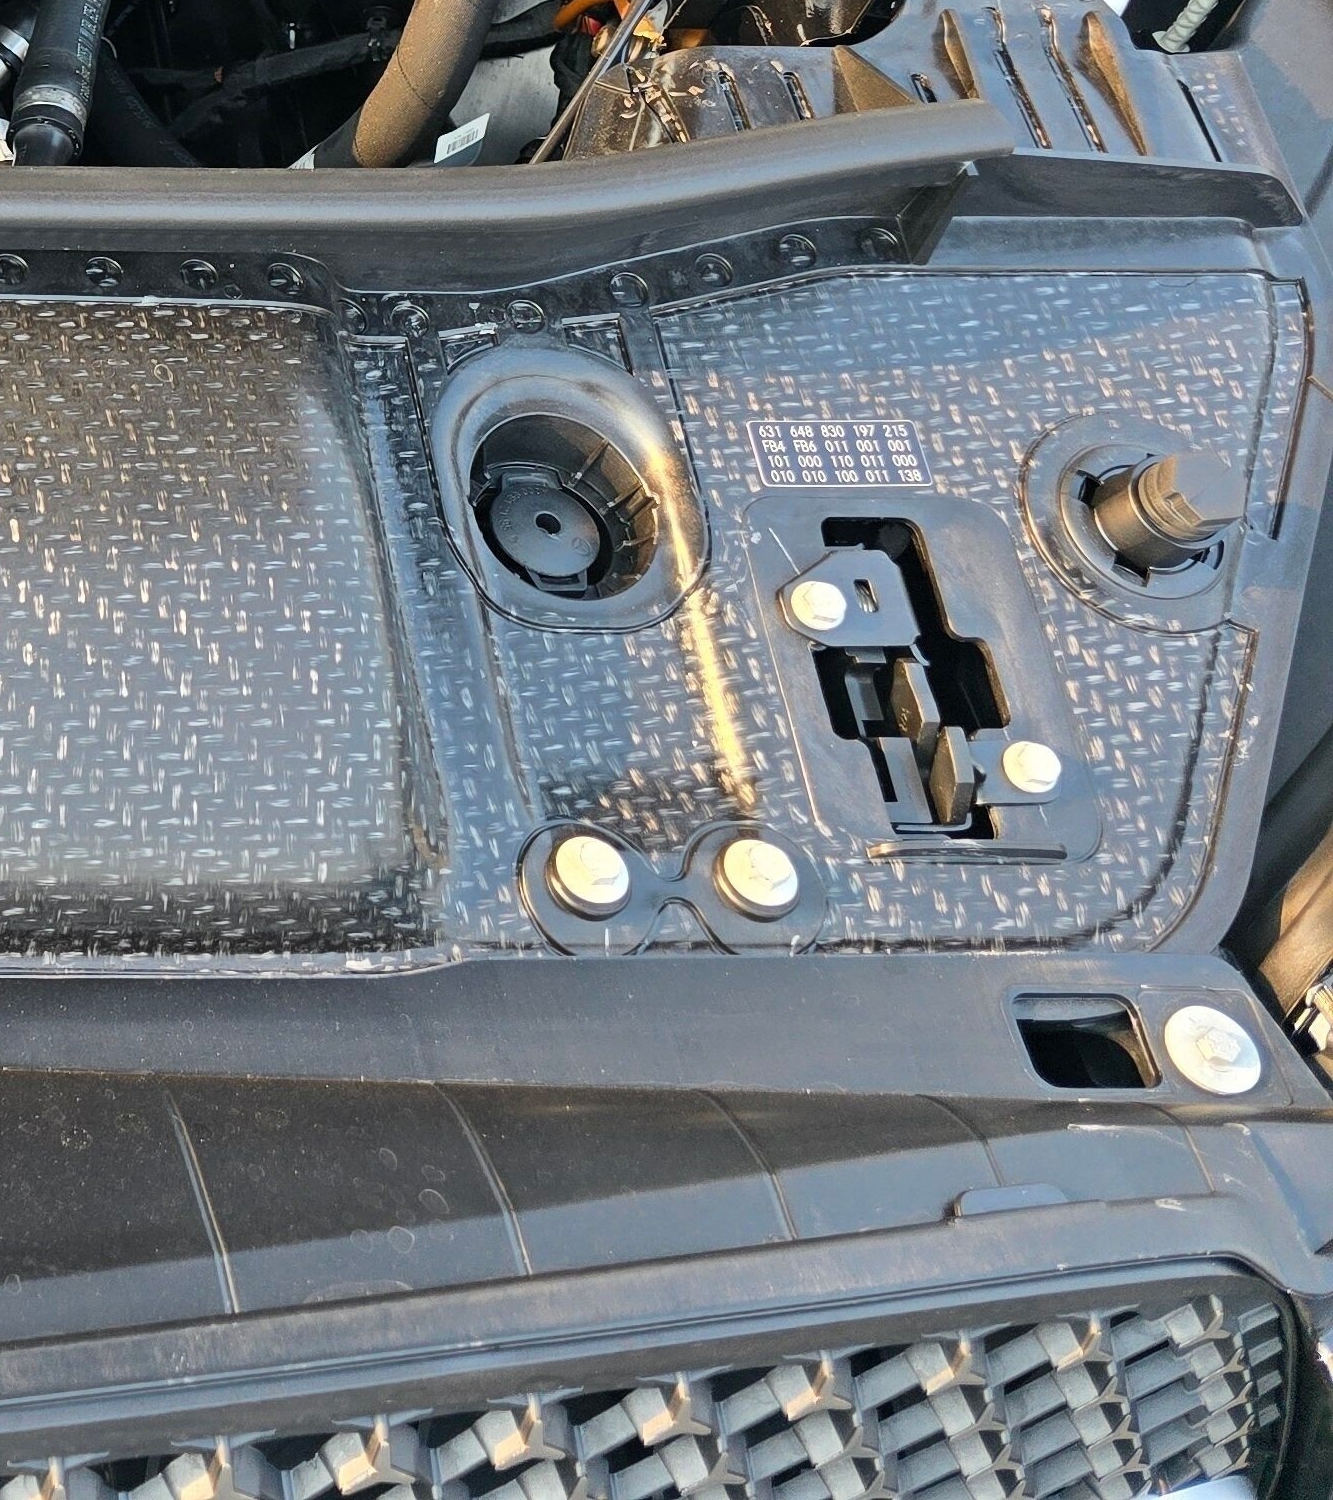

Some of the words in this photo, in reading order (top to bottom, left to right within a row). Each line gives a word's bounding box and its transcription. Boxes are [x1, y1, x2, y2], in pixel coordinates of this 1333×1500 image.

[758, 425, 782, 438] 631
[789, 425, 814, 438] 648
[821, 425, 845, 438] 830
[853, 425, 875, 438] 197
[884, 425, 908, 438] 215
[761, 439, 786, 453] FB4
[793, 439, 817, 453] FB6
[825, 439, 849, 453] 011
[856, 439, 879, 453] 001
[887, 439, 912, 453] 001
[768, 455, 790, 468] 101
[797, 455, 822, 468] 000
[831, 455, 854, 468] 110
[860, 455, 884, 468] 011
[892, 455, 917, 468] 000
[770, 470, 795, 483] 010
[802, 470, 827, 483] 010
[835, 470, 859, 483] 100
[865, 470, 890, 483] 011
[898, 470, 922, 483] 138
